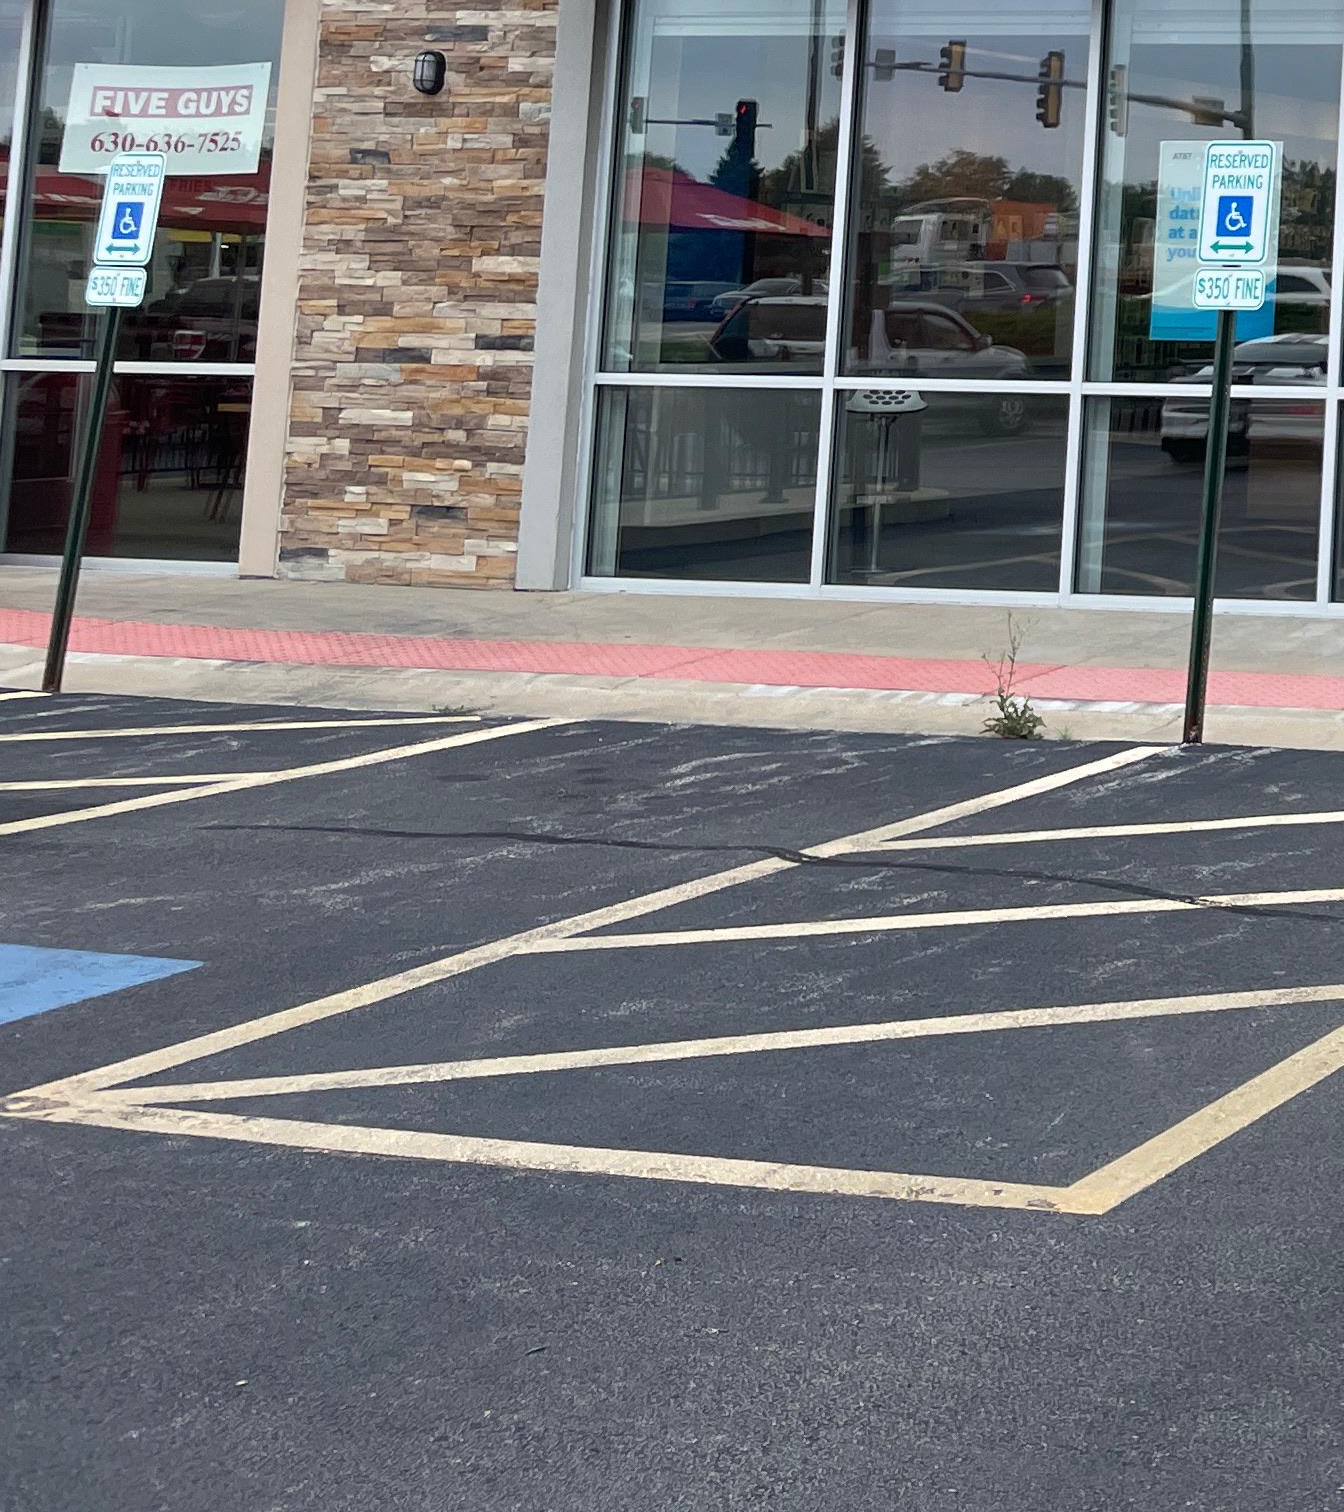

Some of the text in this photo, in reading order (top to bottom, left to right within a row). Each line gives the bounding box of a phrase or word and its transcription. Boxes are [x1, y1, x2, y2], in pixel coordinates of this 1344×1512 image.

[93, 88, 250, 115] FIVE GUYS
[90, 131, 243, 153] 630-636-7525
[1210, 153, 1269, 169] RESERVED
[111, 163, 161, 178] RESERVED
[112, 182, 154, 196] PARKING
[1212, 174, 1264, 189] PARKING
[1167, 226, 1185, 240] at
[91, 276, 143, 297] $350 FINE
[1198, 277, 1261, 299] $350 FINE
